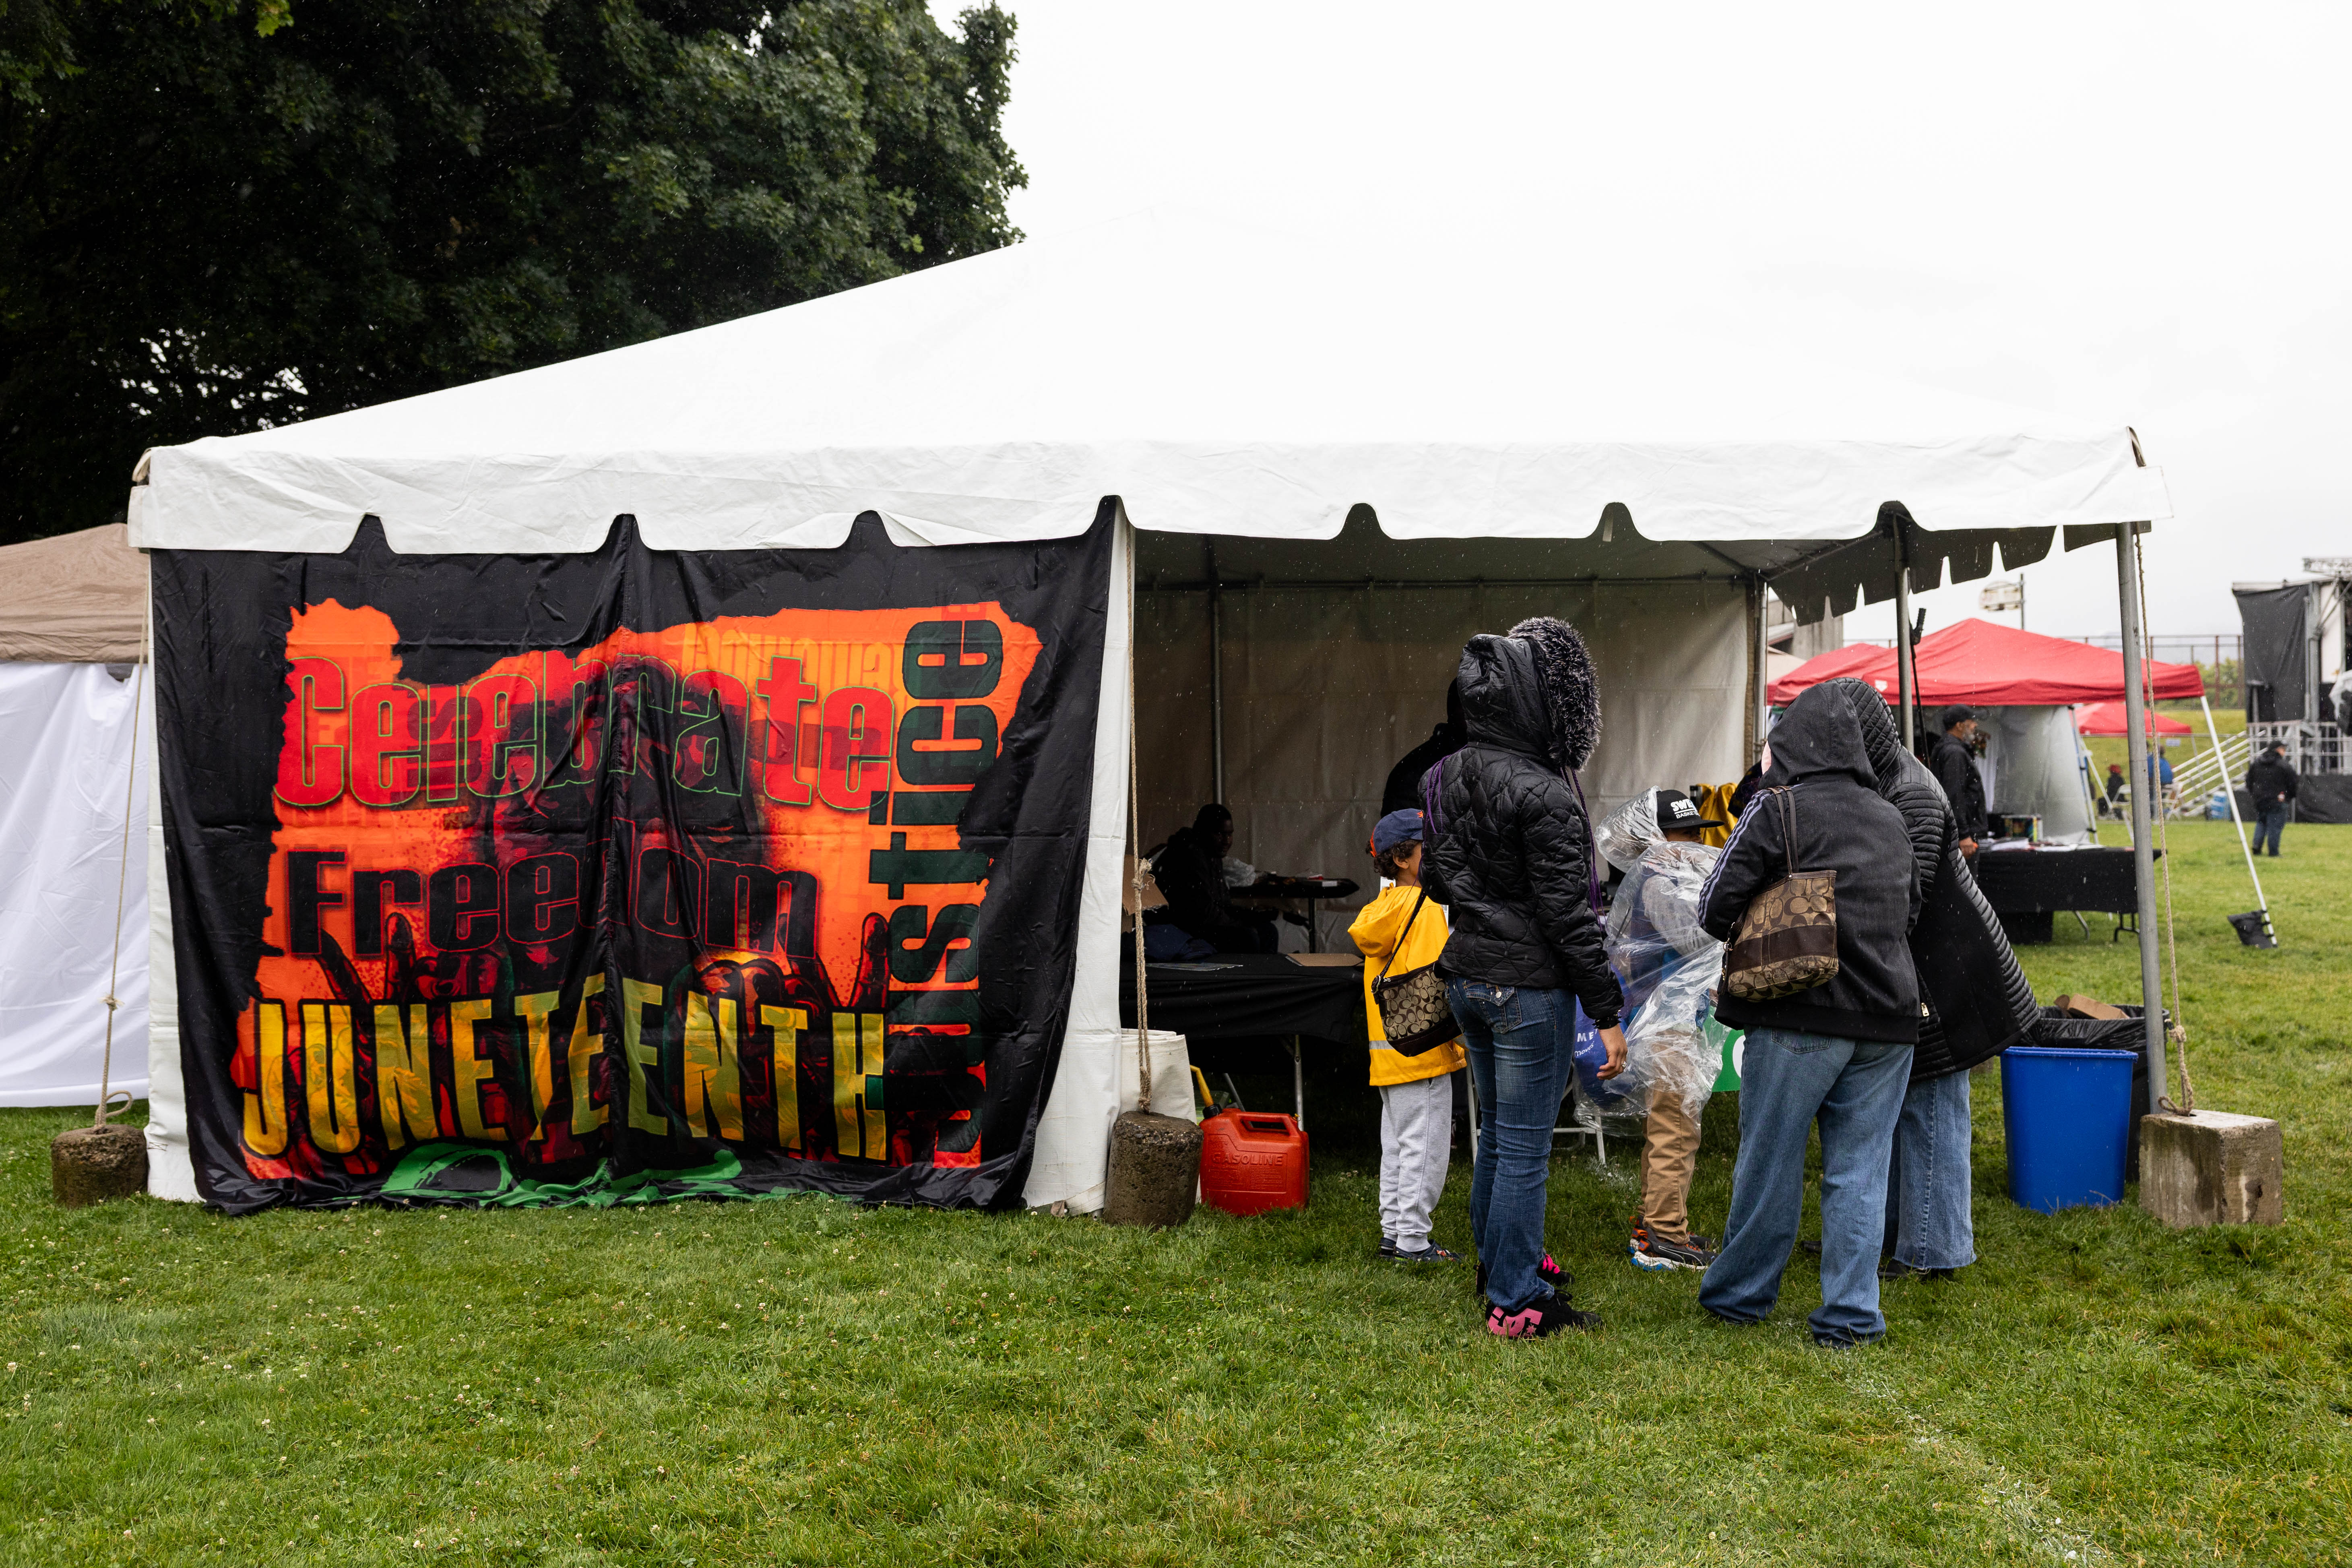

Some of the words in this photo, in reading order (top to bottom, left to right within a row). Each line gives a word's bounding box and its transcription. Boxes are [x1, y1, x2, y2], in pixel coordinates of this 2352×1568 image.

[273, 650, 894, 809] Celebrate
[287, 816, 820, 959] Freedom
[243, 973, 886, 1157] JUNETEENTH
[1212, 1153, 1283, 1166] GASOLINE
